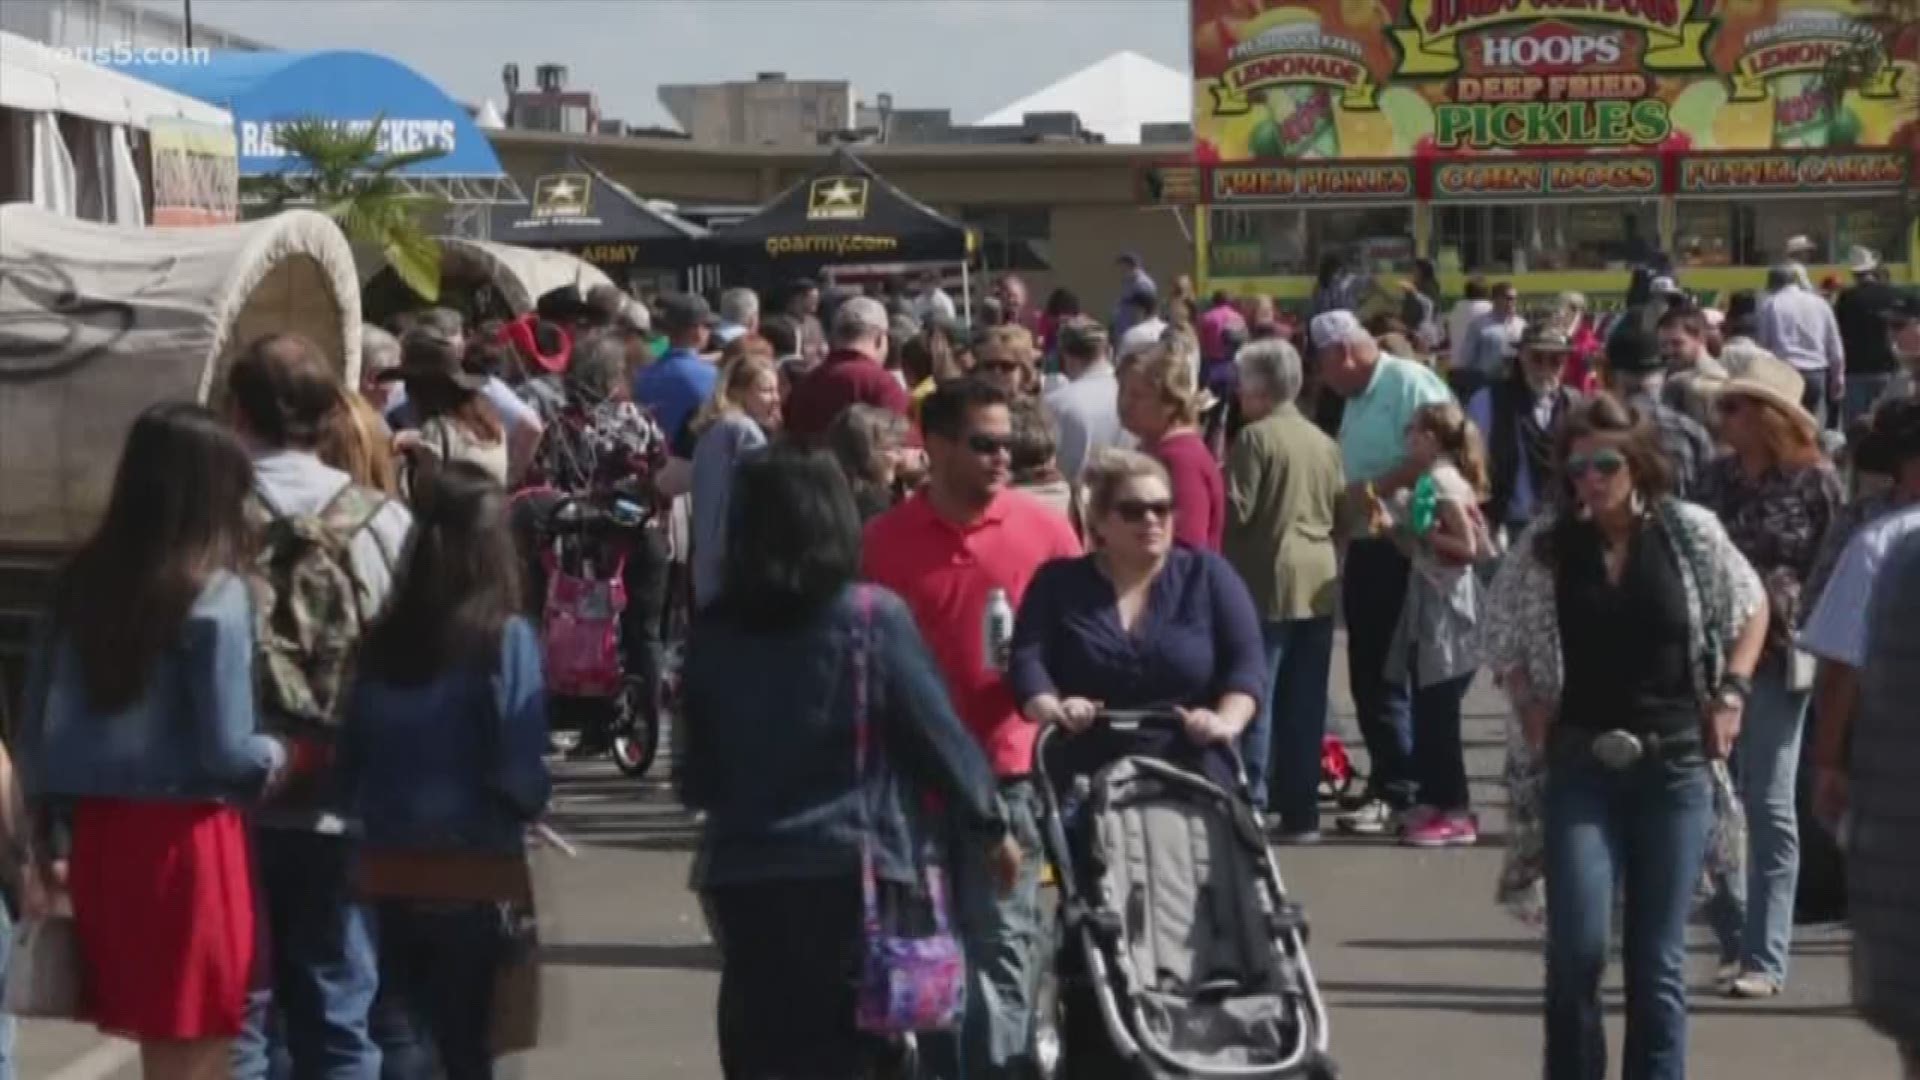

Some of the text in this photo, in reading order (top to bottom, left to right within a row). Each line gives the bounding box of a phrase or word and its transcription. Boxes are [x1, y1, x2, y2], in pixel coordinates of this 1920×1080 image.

[1482, 35, 1621, 67] HOOPS
[1234, 57, 1361, 84] LEMONADE
[1459, 75, 1647, 101] DEEP FRIED
[1436, 101, 1671, 147] PICKLES
[1220, 169, 1296, 197] FRIED
[1299, 167, 1410, 196] PICKLES
[1439, 162, 1656, 193] CORN DOGS
[582, 244, 640, 263] ARMY
[766, 234, 897, 259] goarmy.com
